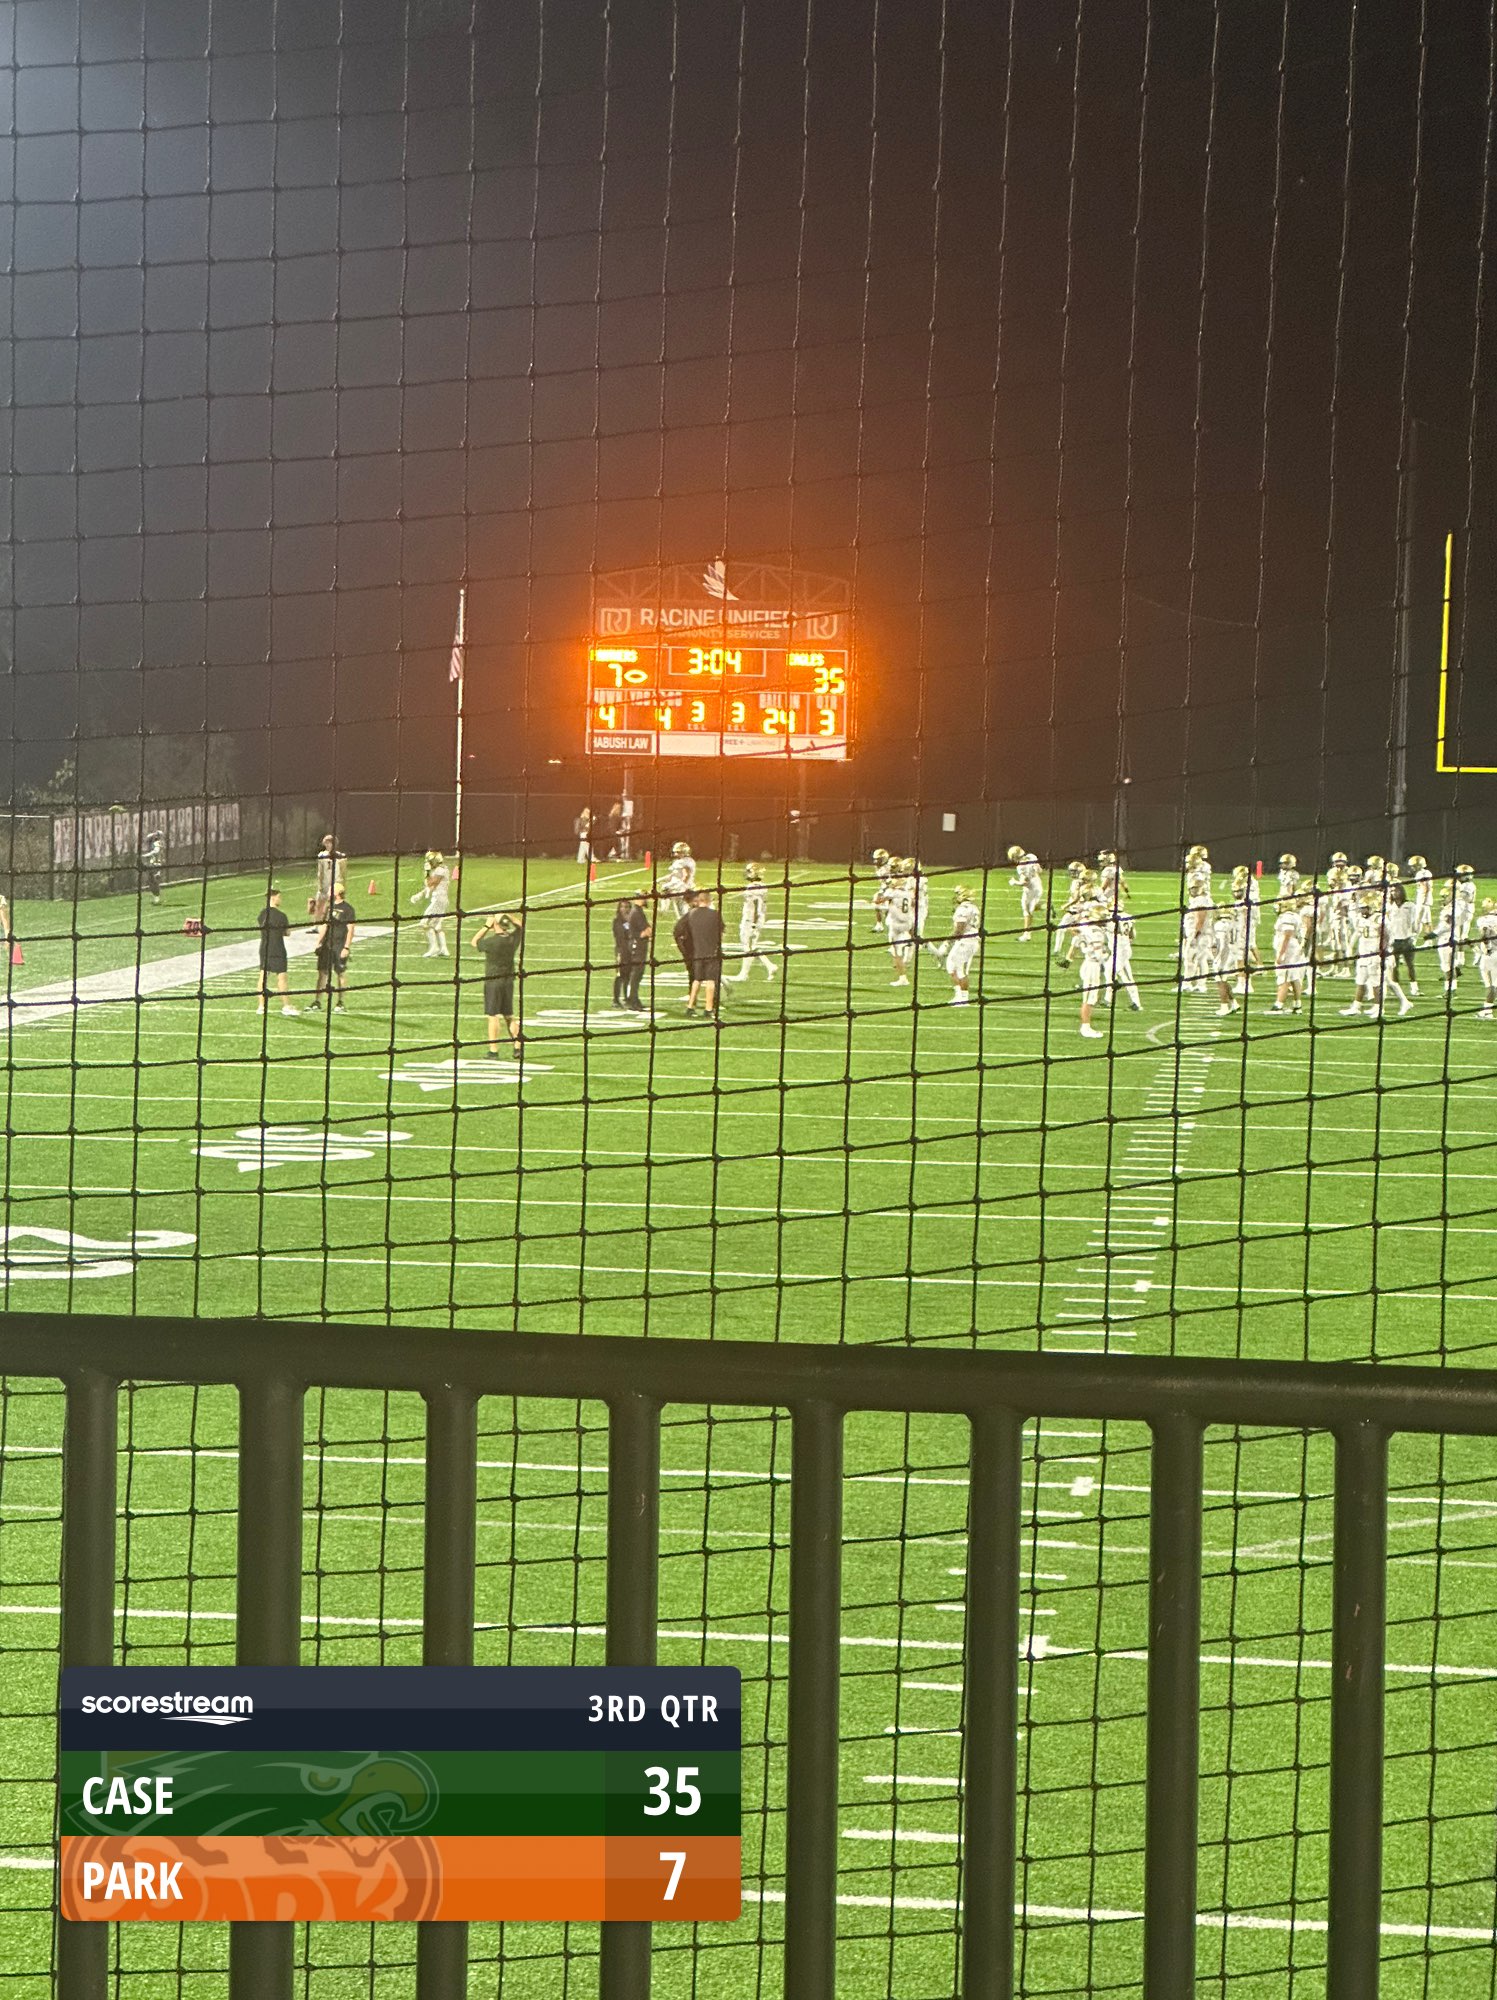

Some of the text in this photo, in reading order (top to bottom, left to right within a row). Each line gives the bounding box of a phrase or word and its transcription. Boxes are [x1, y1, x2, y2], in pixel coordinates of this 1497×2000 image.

[640, 608, 798, 628] RACINE UNIFIED
[727, 629, 781, 640] SERVICES
[688, 648, 743, 675] 3:04
[608, 663, 623, 688] 7
[813, 667, 845, 694] 35
[598, 704, 615, 729] 4
[655, 705, 672, 730] 4
[690, 700, 705, 723] 3
[731, 701, 746, 724] 3
[763, 707, 796, 735] 24
[819, 709, 836, 736] 3
[628, 738, 649, 750] LAW
[190, 1127, 414, 1162] 30
